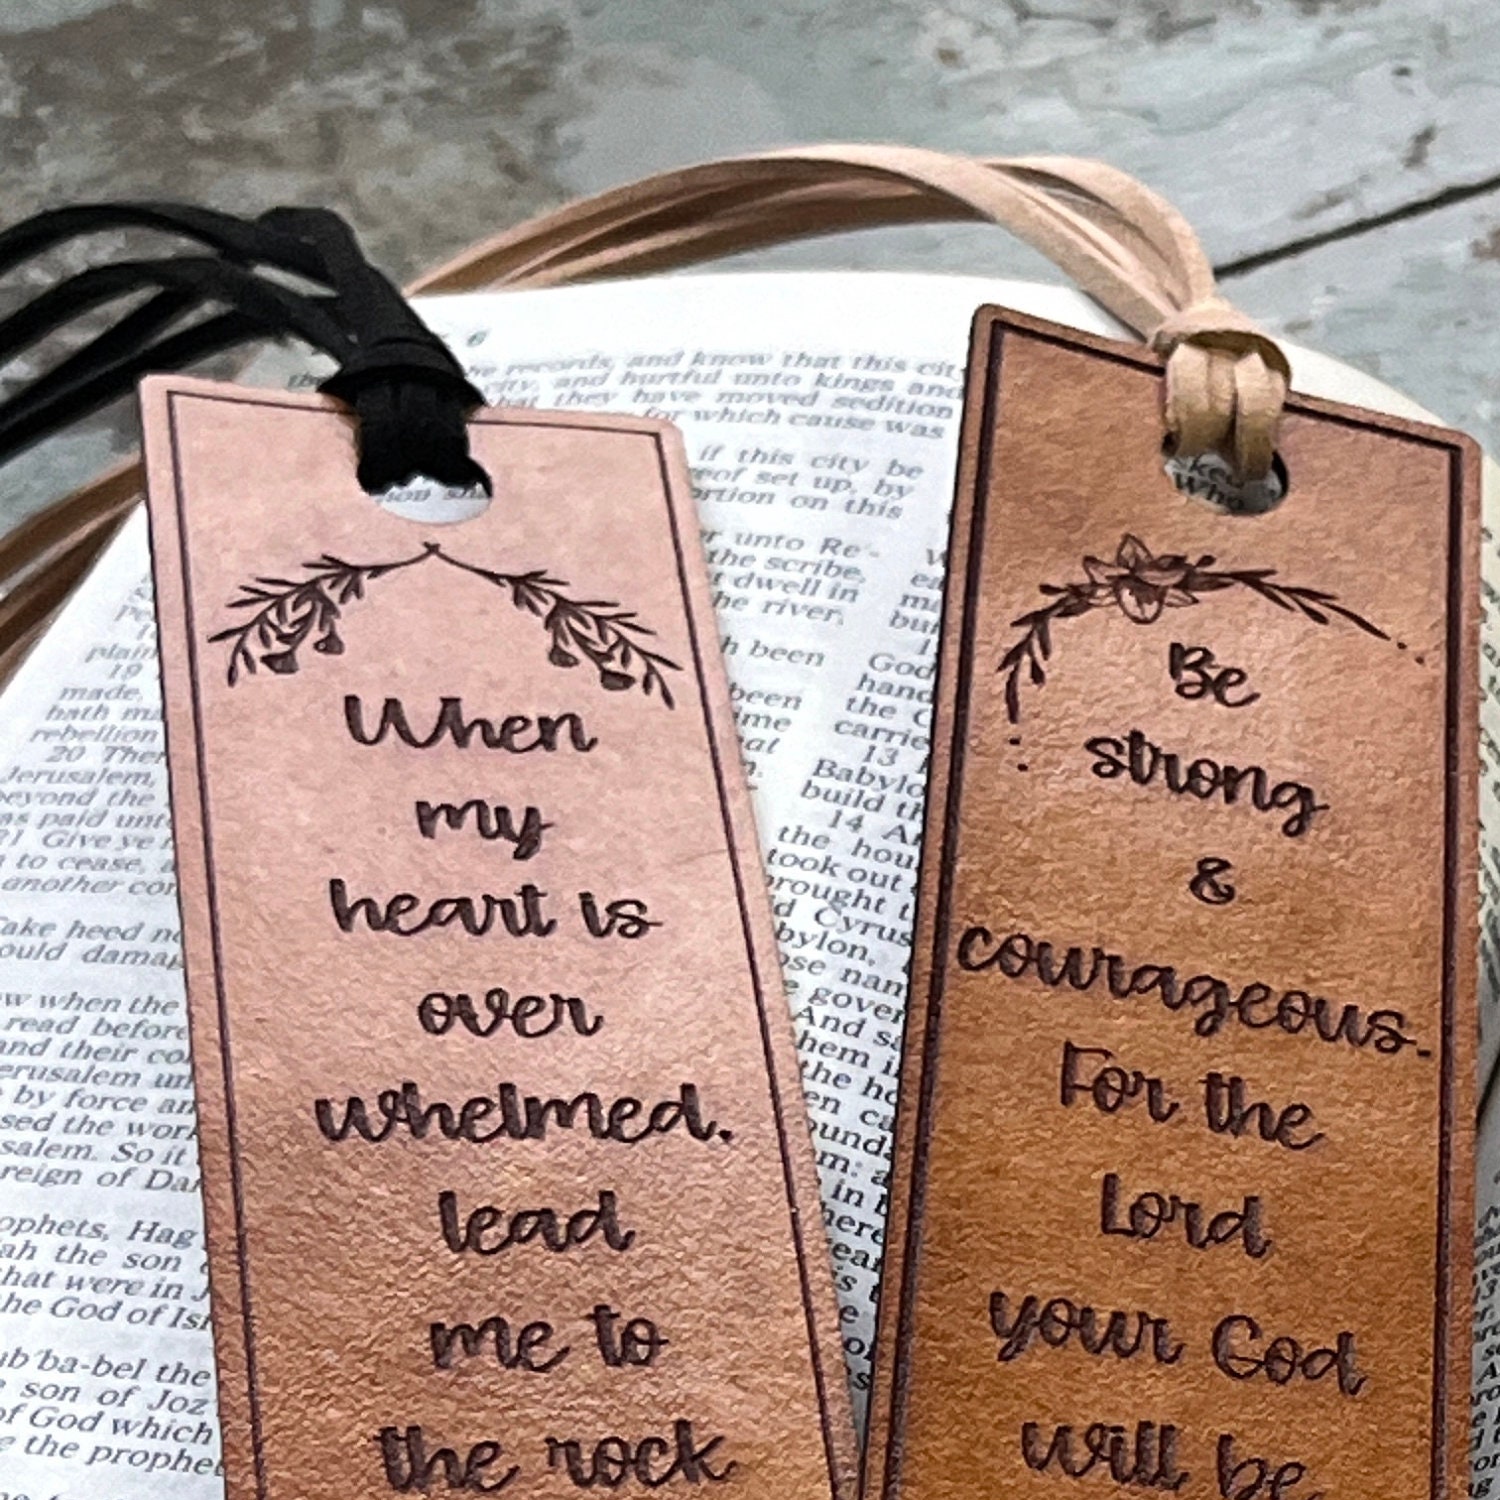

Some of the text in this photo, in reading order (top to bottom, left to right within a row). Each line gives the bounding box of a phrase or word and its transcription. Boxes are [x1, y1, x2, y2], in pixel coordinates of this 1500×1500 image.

[1167, 641, 1259, 708] Be
[344, 695, 598, 752] When
[1083, 730, 1330, 838] strong
[416, 799, 554, 860] my
[329, 879, 661, 939] heart is
[1189, 856, 1234, 904] &
[417, 989, 602, 1036] over
[956, 925, 1433, 1058] courageous.
[314, 1082, 734, 1142] whelmed.
[1059, 1039, 1326, 1150] For the
[437, 1190, 636, 1254] lead
[1100, 1172, 1272, 1259] Lord
[430, 1305, 668, 1372] me to
[989, 1288, 1369, 1396] your God
[110, 1417, 214, 1445] which
[373, 1420, 737, 1494] the rock
[1021, 1420, 1190, 1493] will
